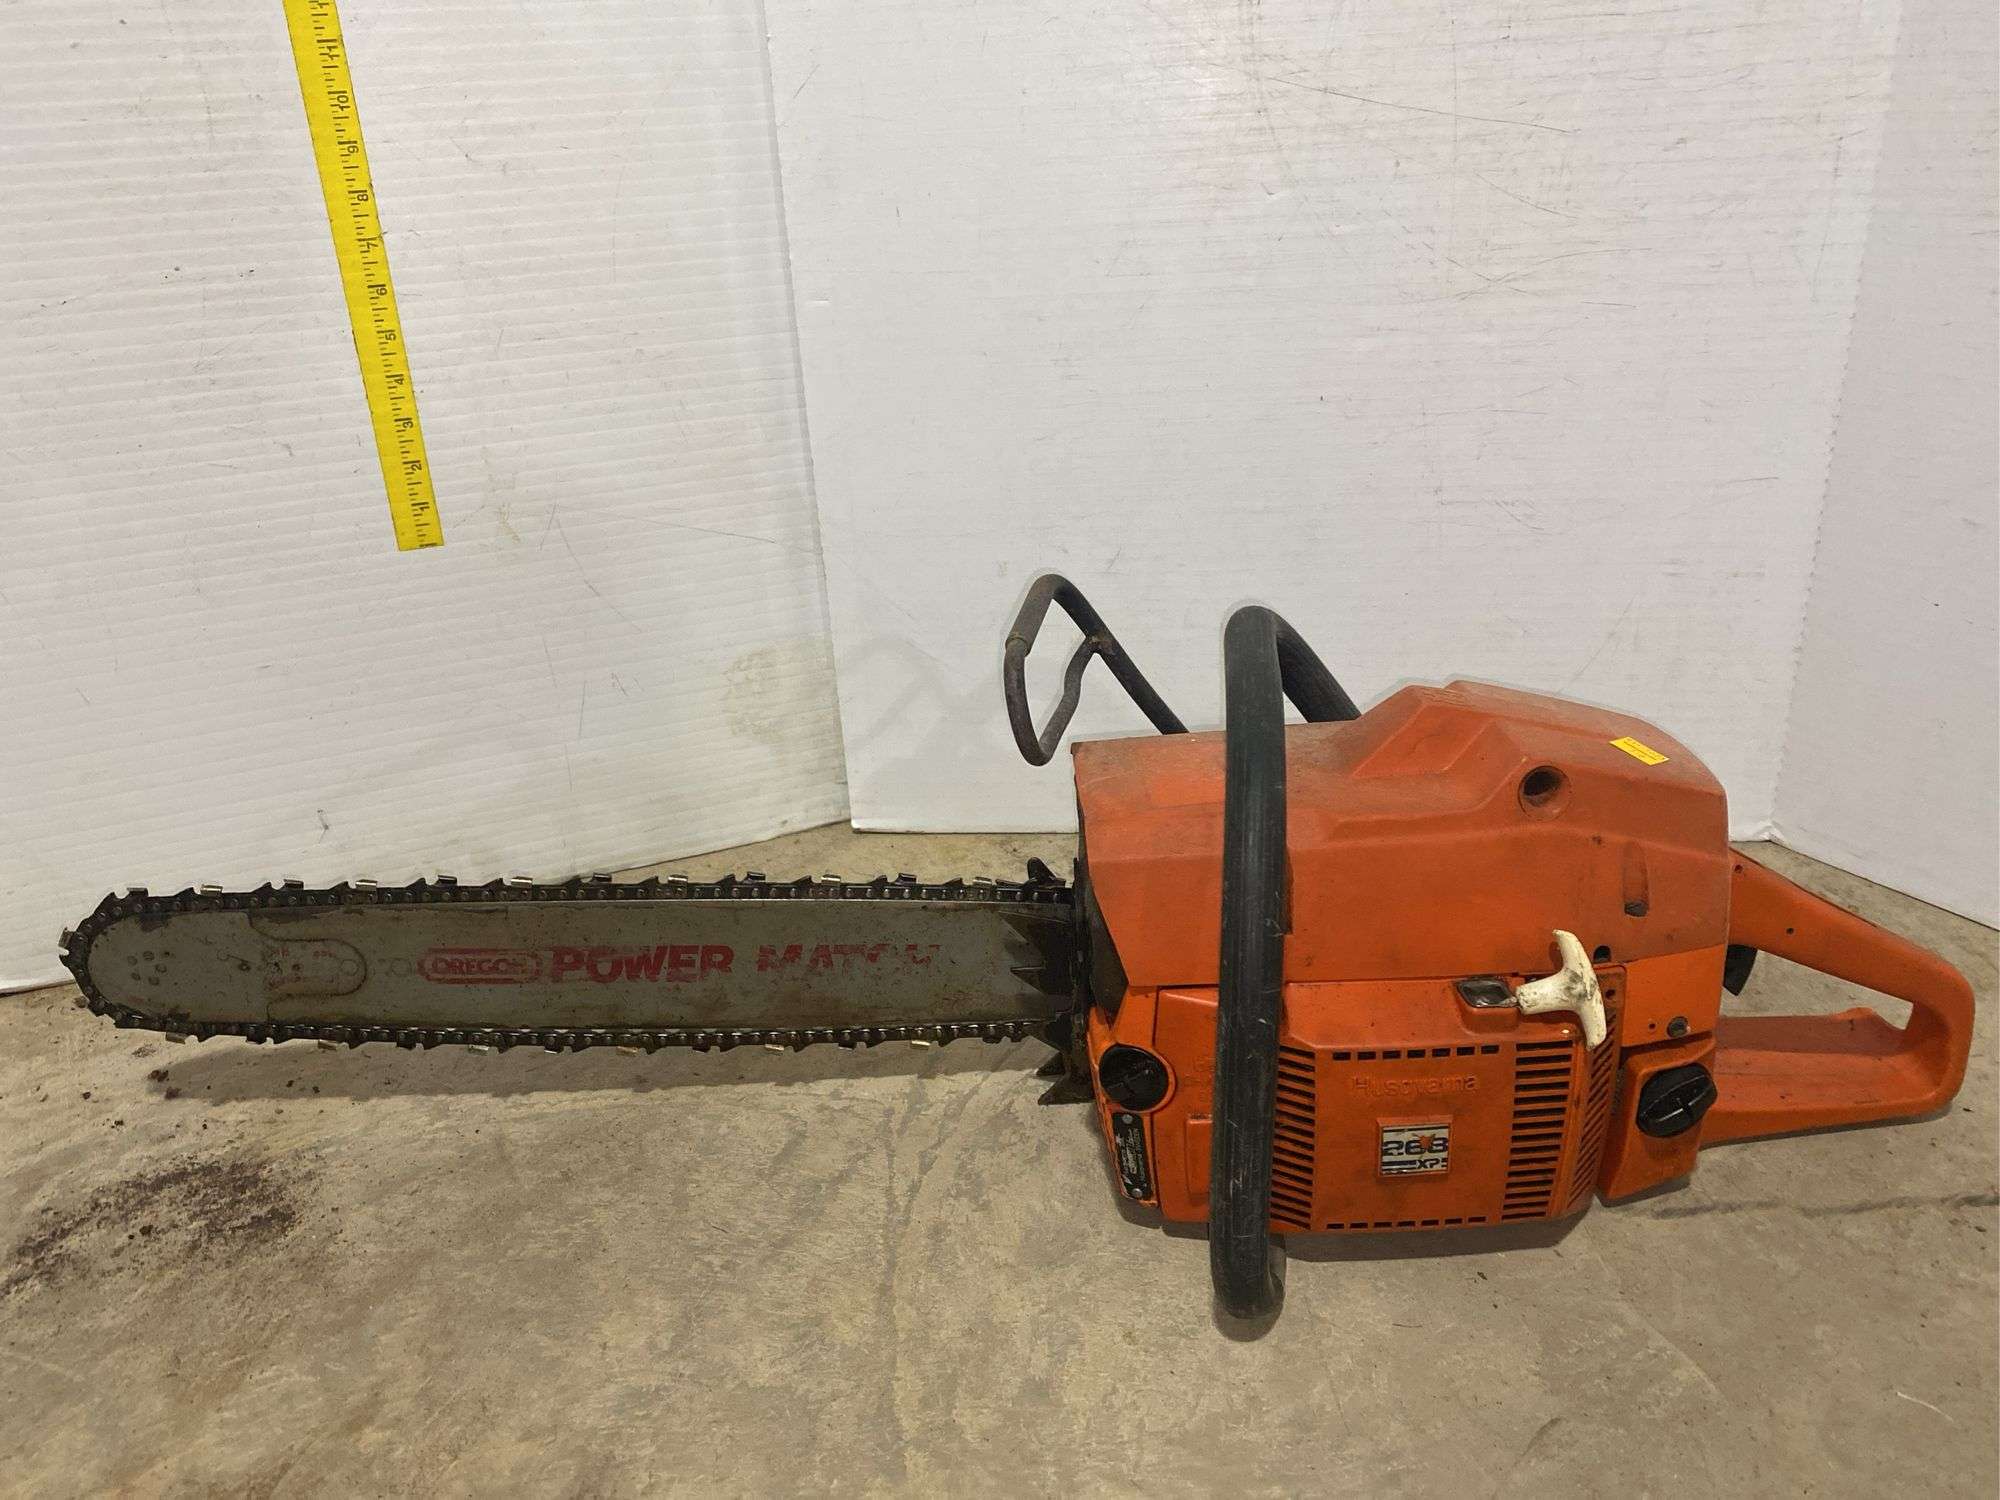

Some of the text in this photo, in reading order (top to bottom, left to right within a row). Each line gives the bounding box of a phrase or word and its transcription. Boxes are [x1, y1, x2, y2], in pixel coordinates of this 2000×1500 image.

[337, 95, 351, 112] 10
[347, 145, 359, 155] 9
[357, 192, 369, 202] 8
[366, 240, 379, 250] 7
[376, 287, 388, 297] 6
[385, 331, 397, 341] 5
[403, 420, 414, 429] 3
[411, 463, 422, 473] 2
[549, 944, 735, 984] POWER
[1383, 1136, 1449, 1156] 268
